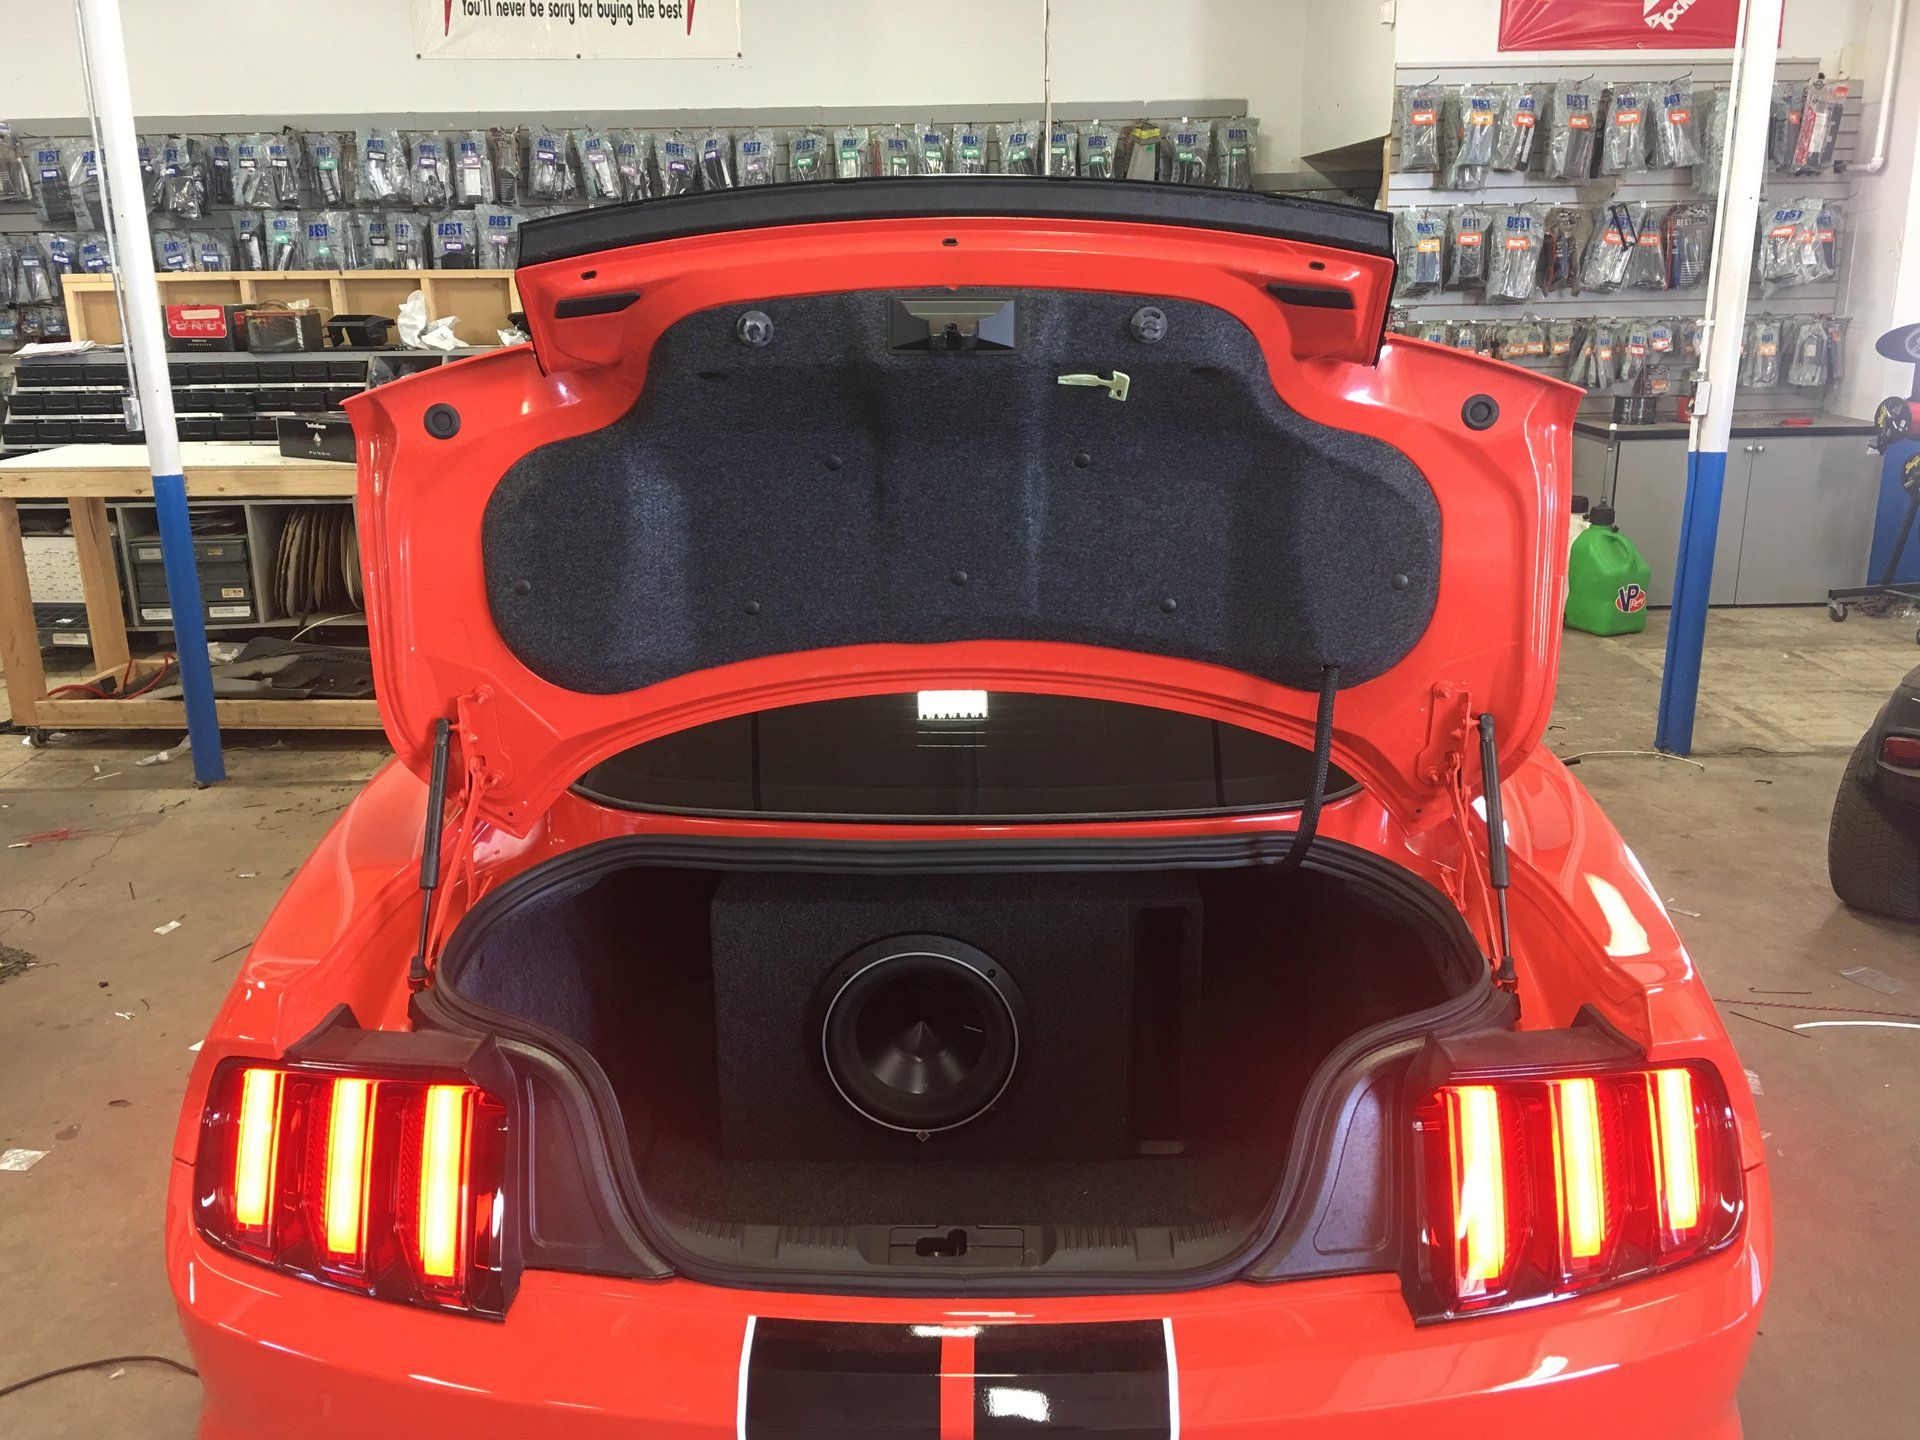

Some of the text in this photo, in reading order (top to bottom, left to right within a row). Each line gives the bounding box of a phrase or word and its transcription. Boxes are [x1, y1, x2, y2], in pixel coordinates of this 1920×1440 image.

[496, 2, 526, 17] never
[530, 0, 544, 17] be
[548, 2, 575, 25] sorry
[578, 0, 592, 18] for
[597, 0, 633, 26] buying
[637, 0, 654, 19] the
[659, 0, 682, 19] best
[1472, 99, 1490, 110] BEST
[1567, 94, 1589, 108] BEST
[1228, 129, 1248, 140] BEST
[796, 139, 815, 150] BEST
[488, 215, 513, 228] BEST
[1506, 215, 1532, 230] BEST
[1775, 210, 1804, 222] BEST
[309, 223, 328, 237] BEST
[437, 222, 463, 236] BEST
[1462, 218, 1480, 229] BEST
[202, 243, 218, 252] BEST
[1618, 584, 1640, 612] VP
